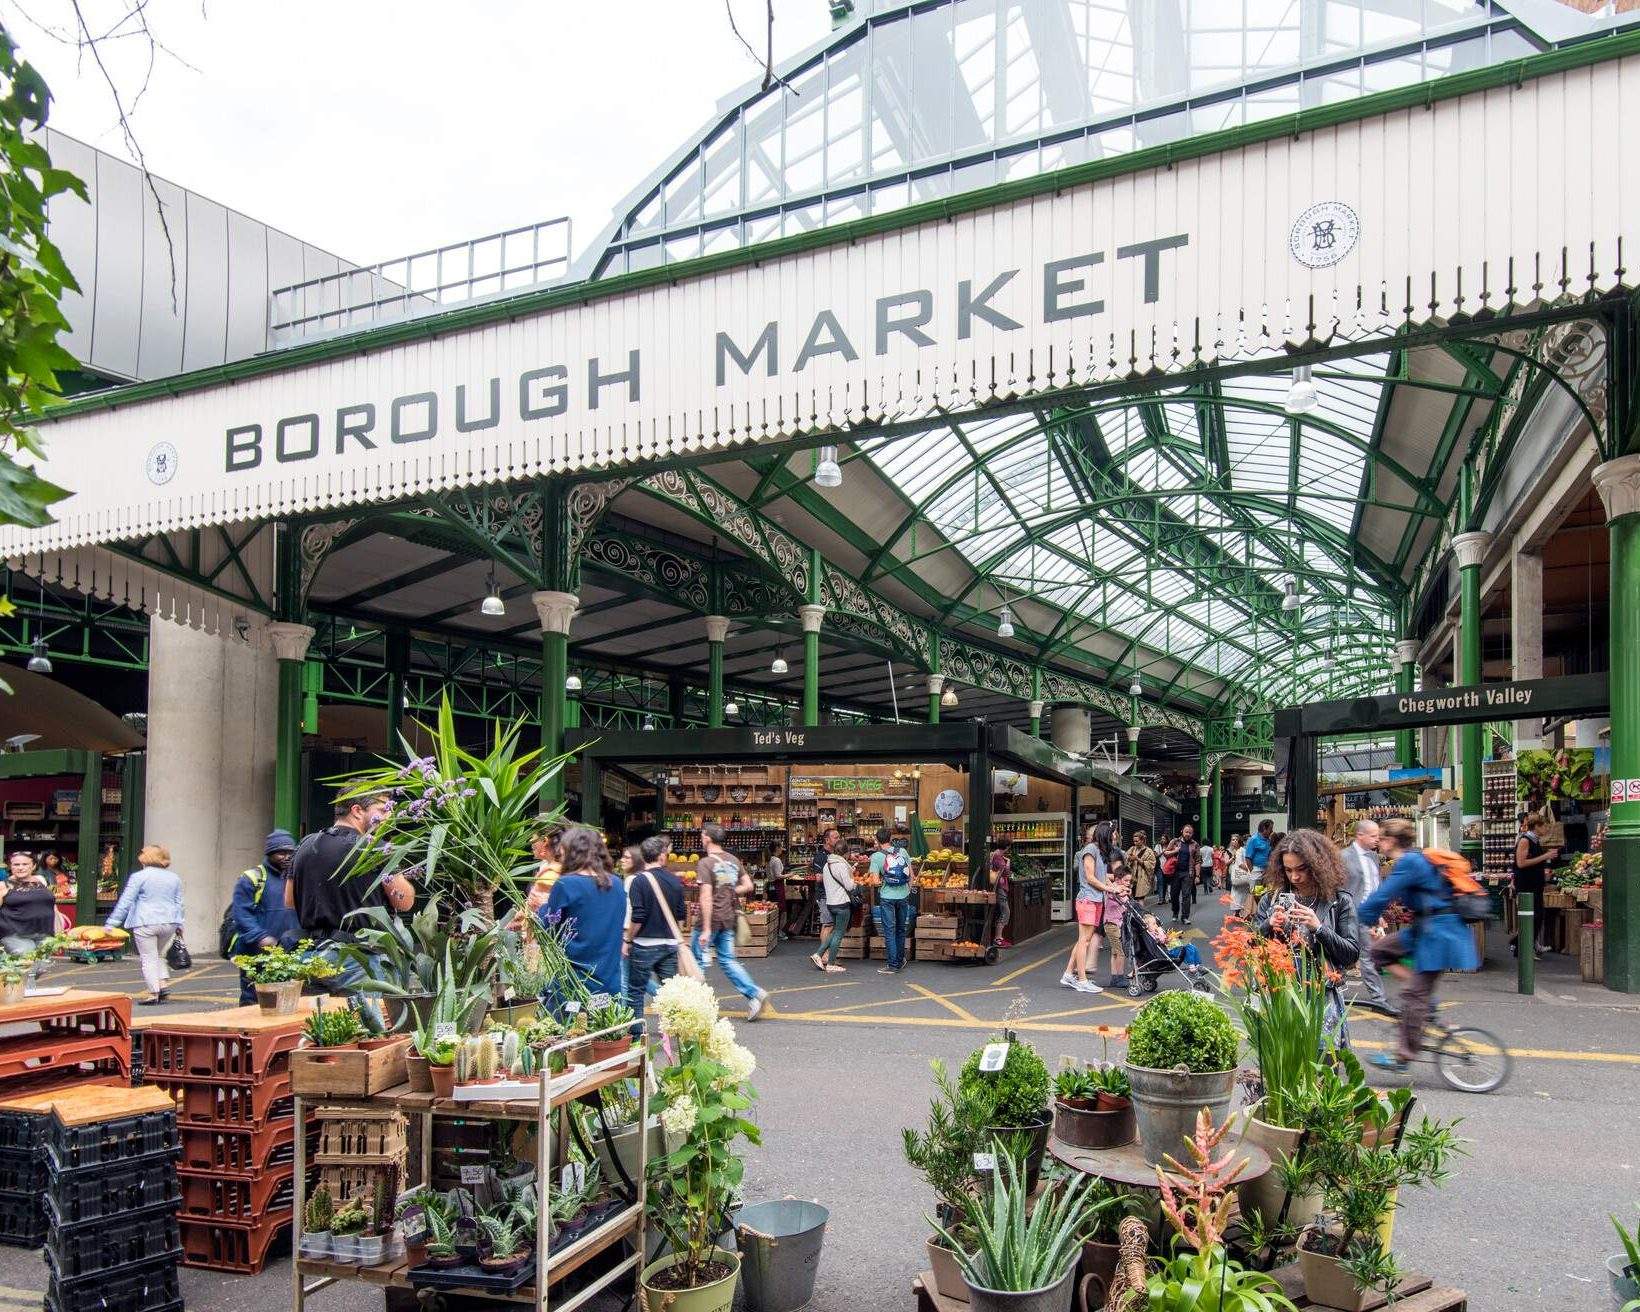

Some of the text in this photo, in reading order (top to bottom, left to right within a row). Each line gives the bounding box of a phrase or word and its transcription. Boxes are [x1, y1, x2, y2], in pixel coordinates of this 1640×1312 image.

[225, 233, 1189, 473] BOROUGH MARKET
[1398, 687, 1532, 713] Chegworth Valley
[753, 731, 805, 746] Ted's Veg
